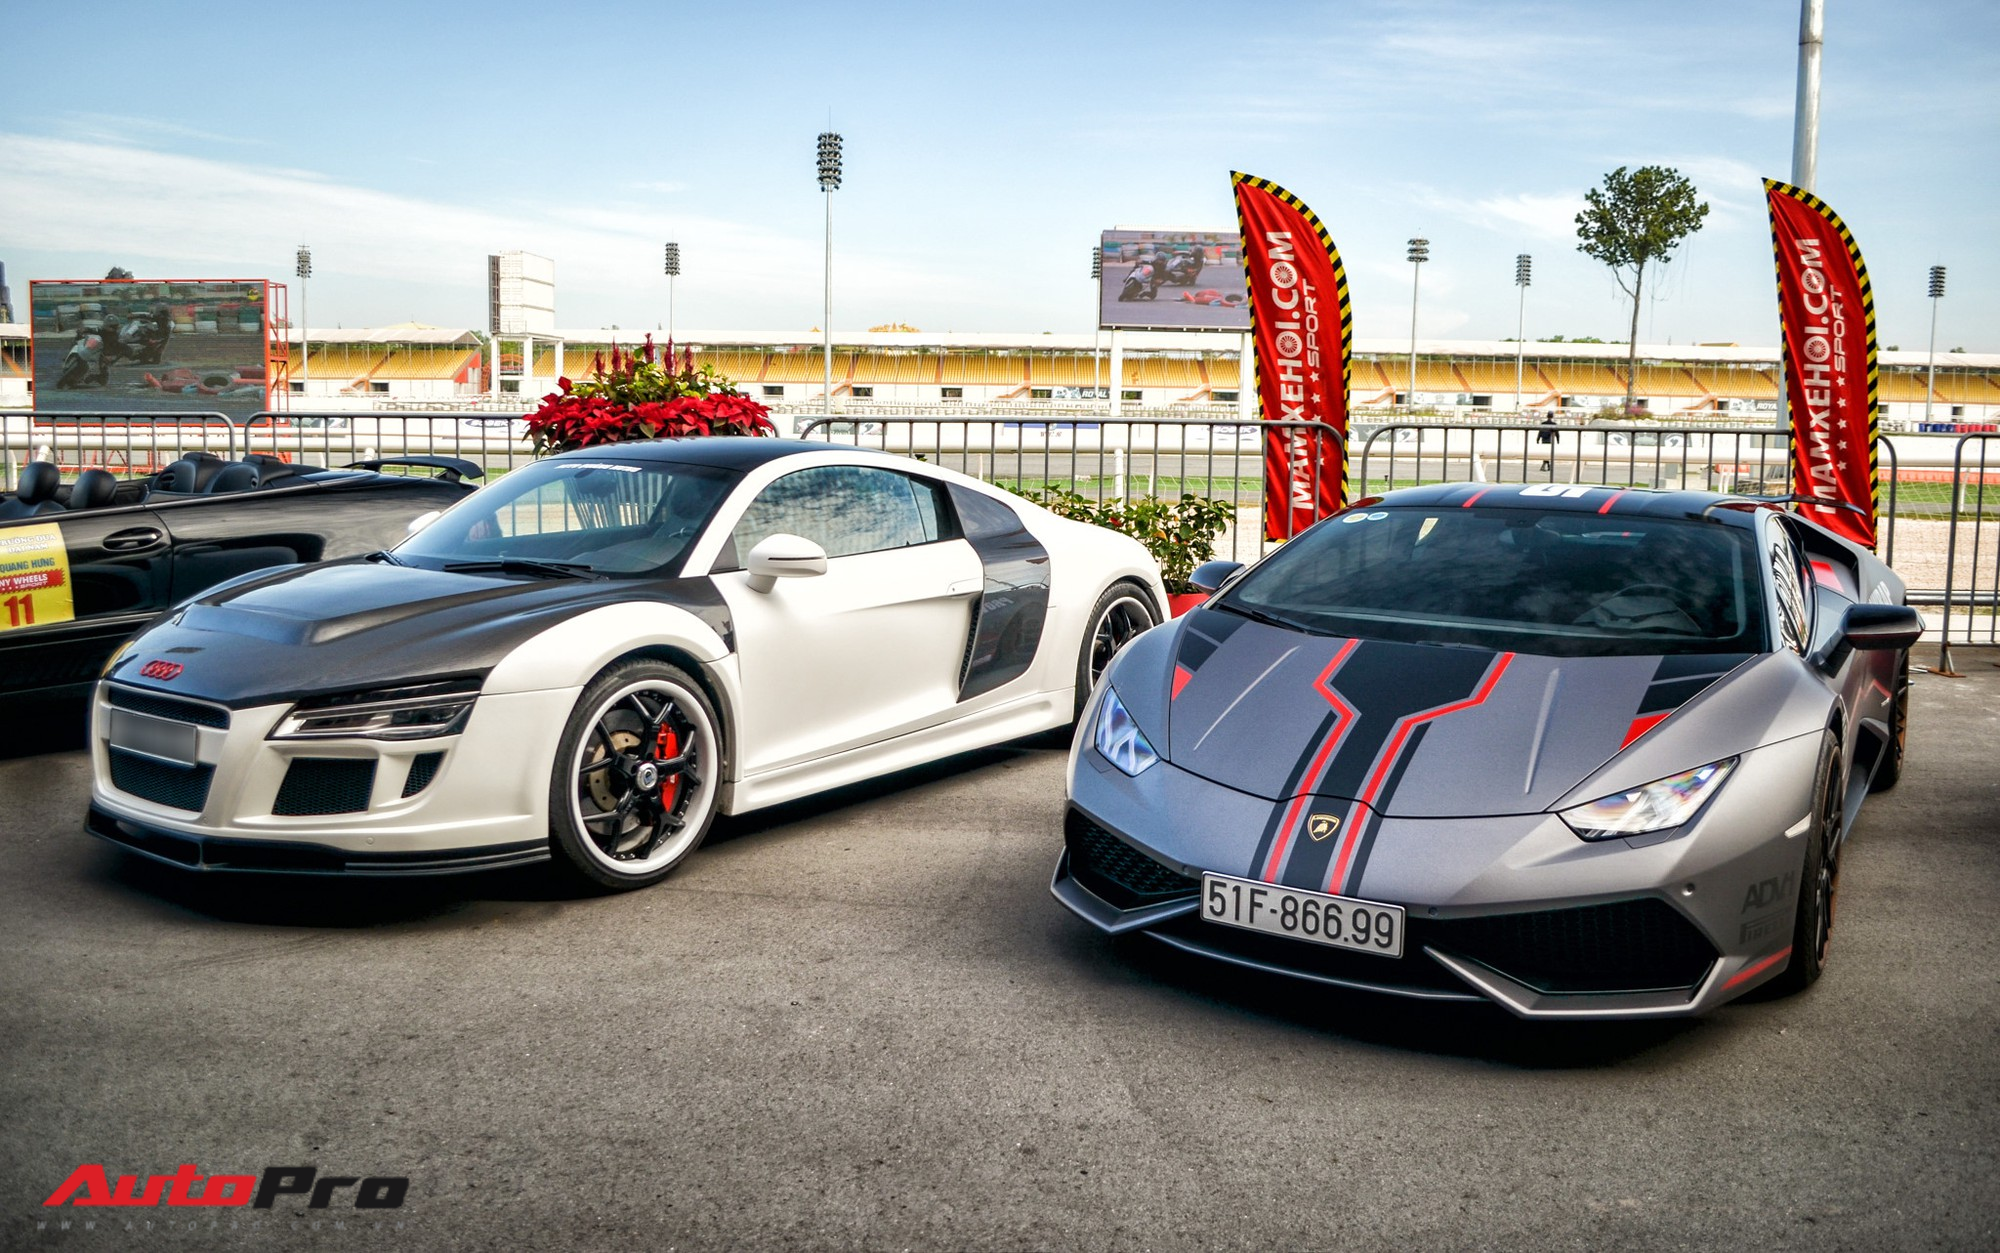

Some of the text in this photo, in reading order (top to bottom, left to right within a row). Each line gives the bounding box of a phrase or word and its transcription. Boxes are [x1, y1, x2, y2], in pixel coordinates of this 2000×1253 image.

[1302, 278, 1320, 369] SPORT
[1829, 284, 1846, 373] SPORT
[1266, 231, 1314, 510] MAMXEHOI.COM
[1796, 238, 1837, 514] MAMXEHOI.COM
[0, 560, 29, 573] QUANG
[13, 573, 48, 585] WHEELS
[20, 580, 48, 589] SPORT
[3, 593, 35, 627] 11
[1208, 878, 1395, 949] 51F-866.99
